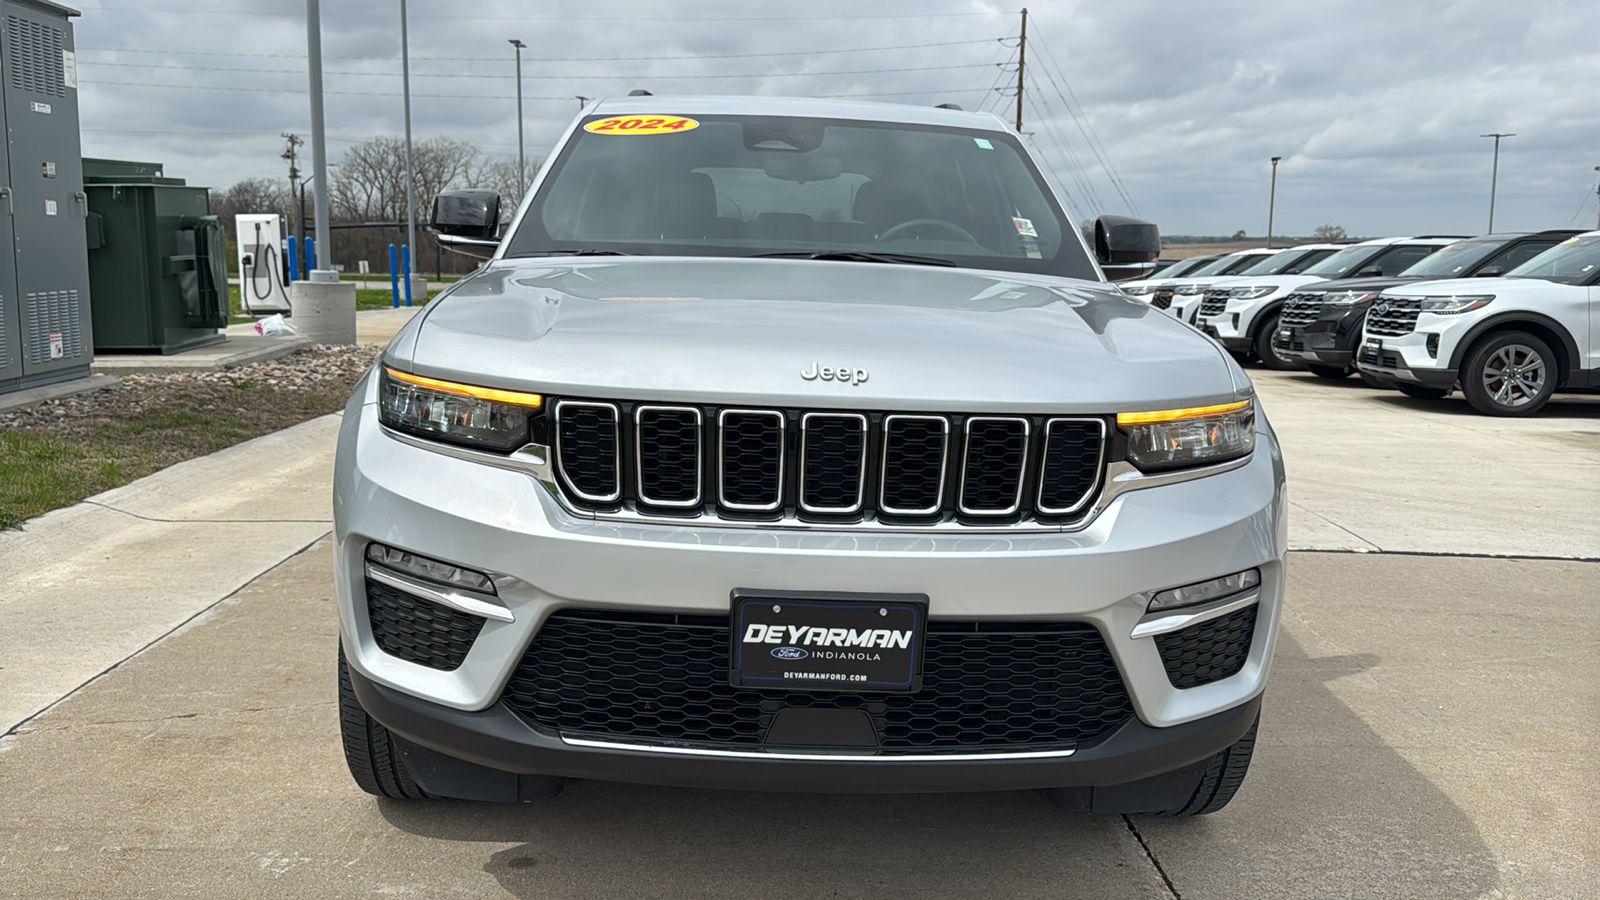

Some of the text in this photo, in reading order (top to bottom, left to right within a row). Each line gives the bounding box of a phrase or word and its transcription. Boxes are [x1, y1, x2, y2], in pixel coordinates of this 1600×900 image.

[594, 119, 689, 131] 2024
[800, 362, 868, 386] Jeep
[743, 624, 913, 649] DEYARMAN
[812, 651, 881, 661] INDIANOLA
[784, 671, 867, 682] DEYARMANFORD.COM
